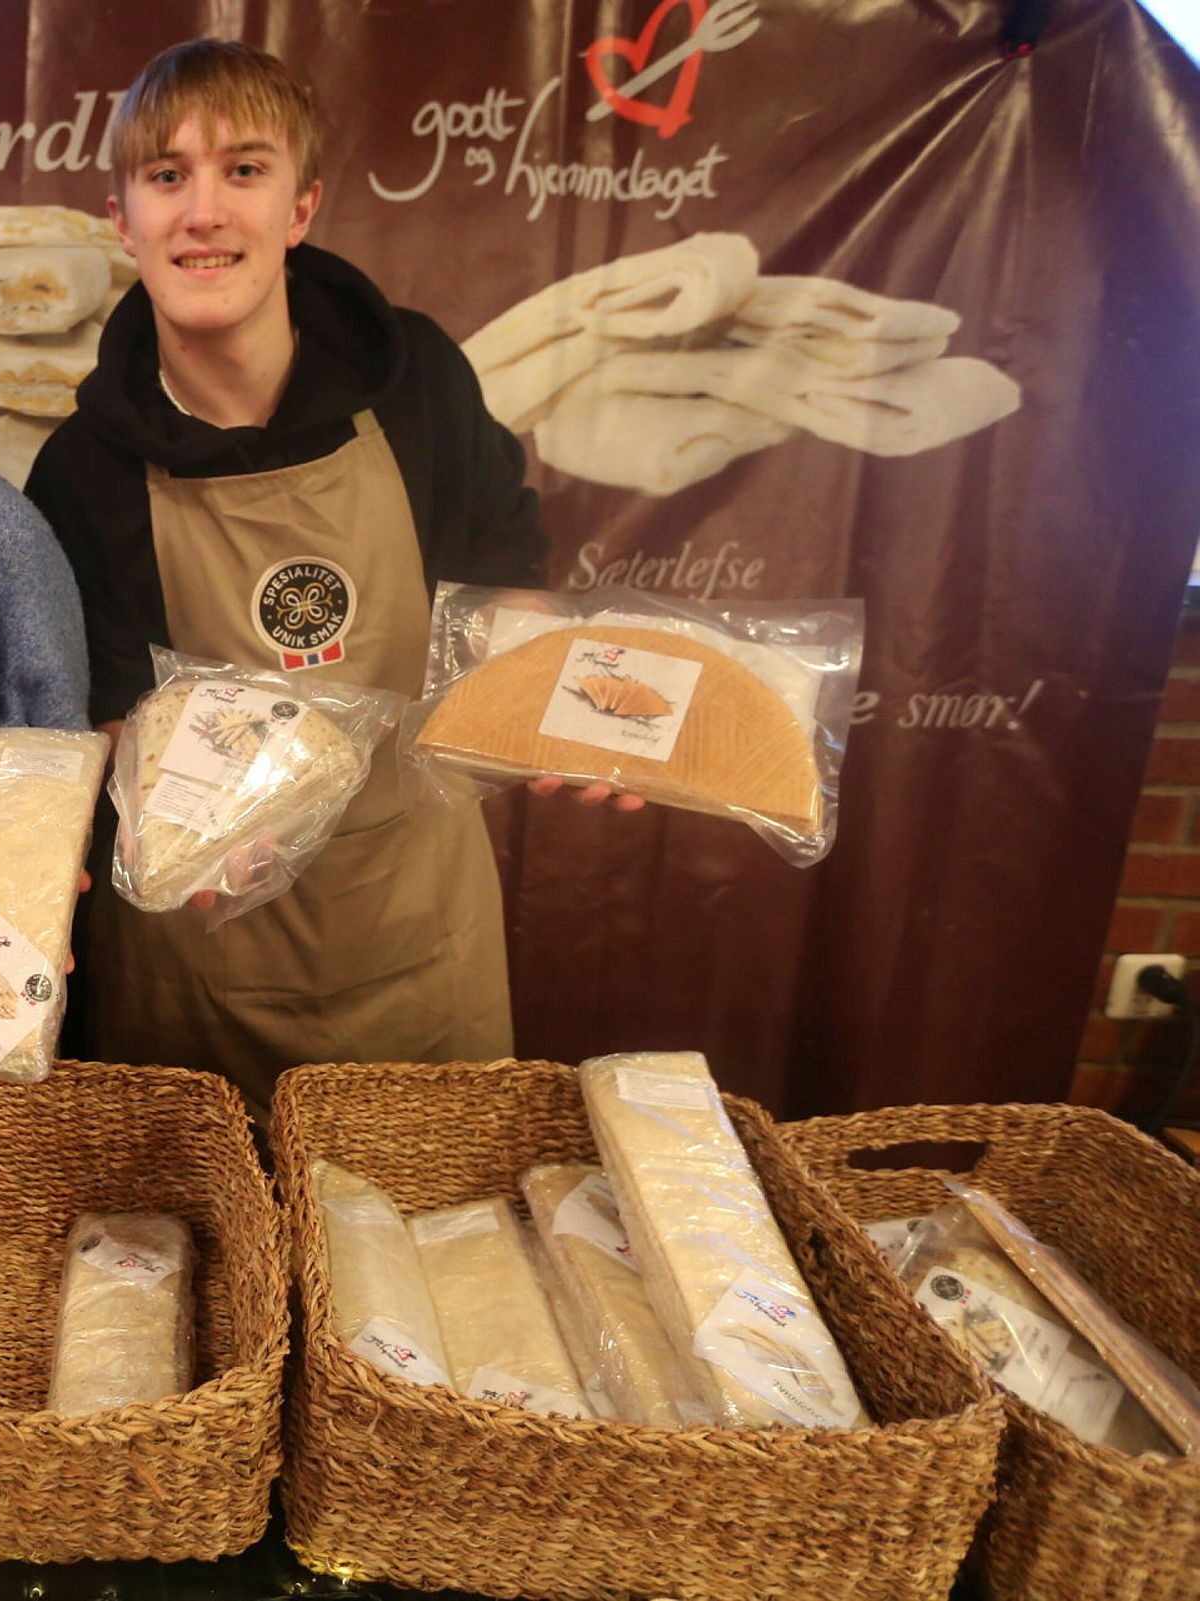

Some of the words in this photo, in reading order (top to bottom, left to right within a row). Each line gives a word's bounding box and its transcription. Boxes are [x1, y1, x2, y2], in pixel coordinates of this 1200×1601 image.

[368, 88, 526, 202] godt
[463, 146, 497, 186] og
[262, 565, 343, 607] SPESIALITET
[271, 625, 306, 648] UNIK
[309, 612, 344, 646] SMAK
[849, 690, 882, 726] e
[896, 678, 1045, 731] smør!
